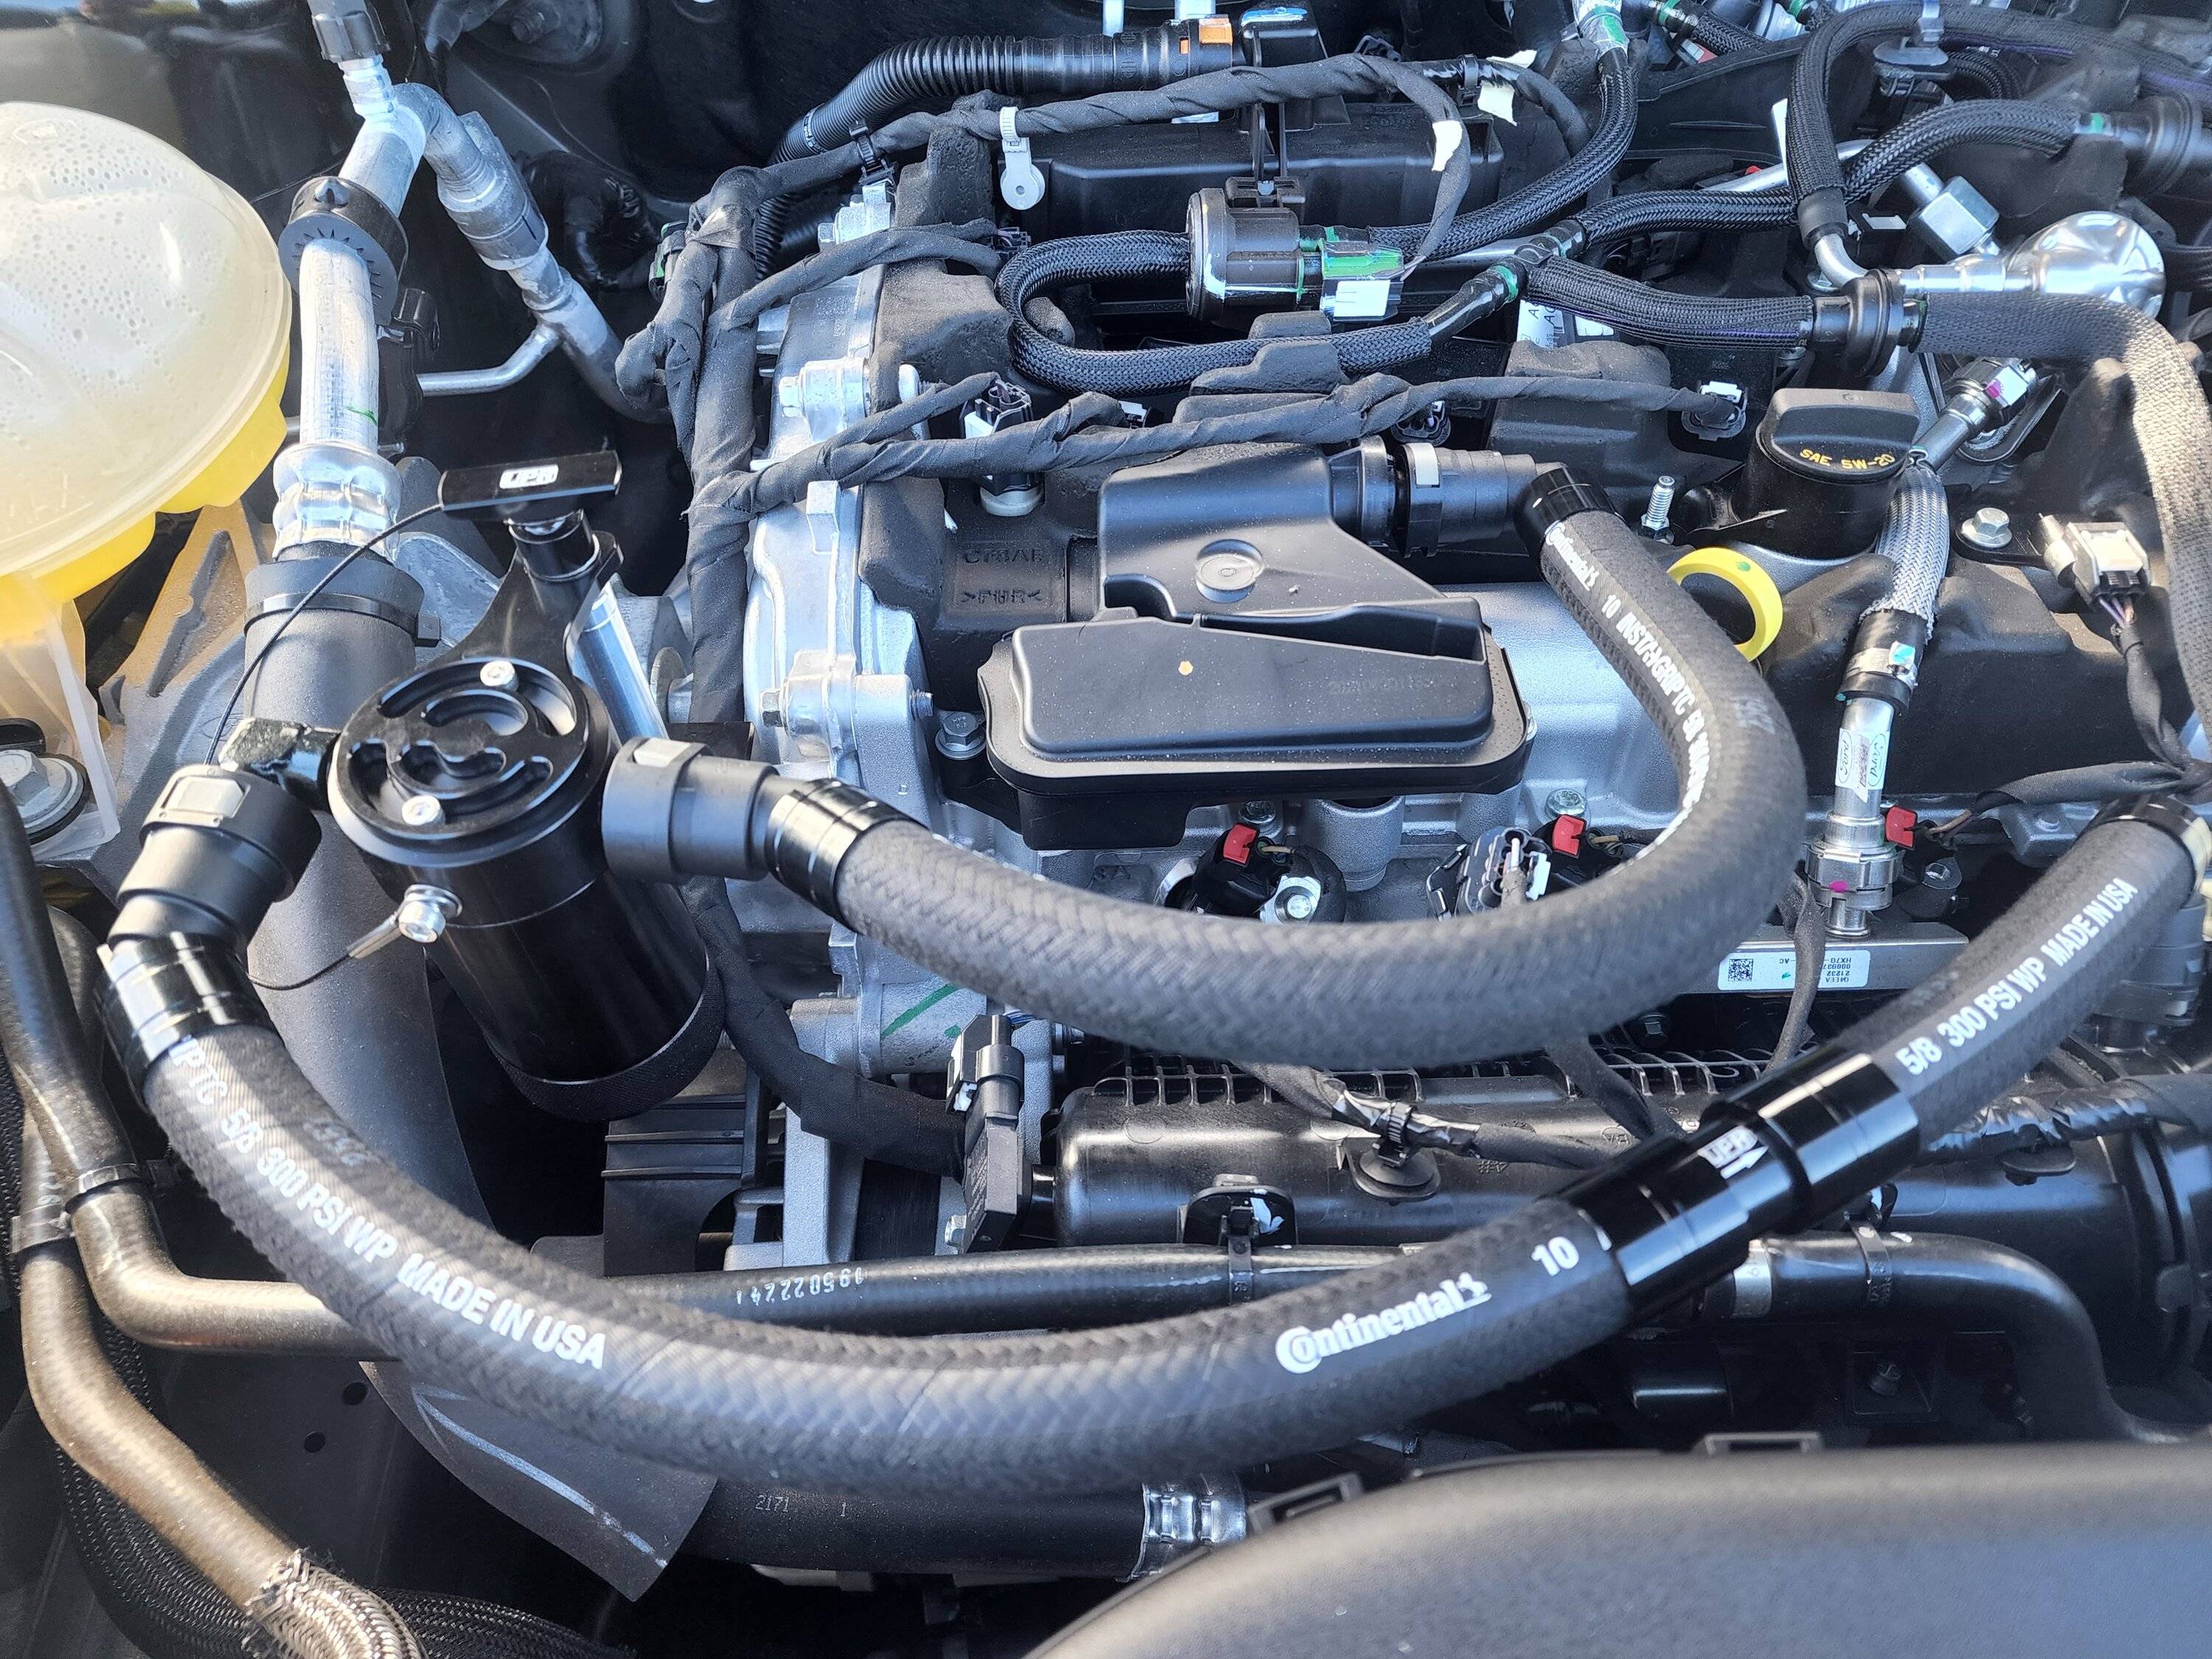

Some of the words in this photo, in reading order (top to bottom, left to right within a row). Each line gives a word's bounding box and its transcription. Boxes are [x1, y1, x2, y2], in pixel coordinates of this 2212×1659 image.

[1799, 448, 1832, 467] SAE
[1840, 453, 1896, 470] 5W-20
[1601, 594, 1621, 619] 10
[2083, 900, 2114, 928] IN
[2097, 877, 2138, 912] USA
[2040, 914, 2099, 967] MADE
[2006, 957, 2046, 993] WP
[1974, 979, 2023, 1021] PSI
[1936, 1006, 1987, 1048] 300
[1895, 1037, 1942, 1075] 5/8
[1697, 1125, 1759, 1169] UPR
[257, 1147, 308, 1198] 300
[296, 1182, 354, 1236] PSI
[344, 1215, 399, 1264] WP
[396, 1253, 496, 1325] MADE
[490, 1299, 535, 1341] IN
[532, 1315, 605, 1369] USA
[1276, 1277, 1467, 1374] Continental
[1531, 1236, 1580, 1276] 10
